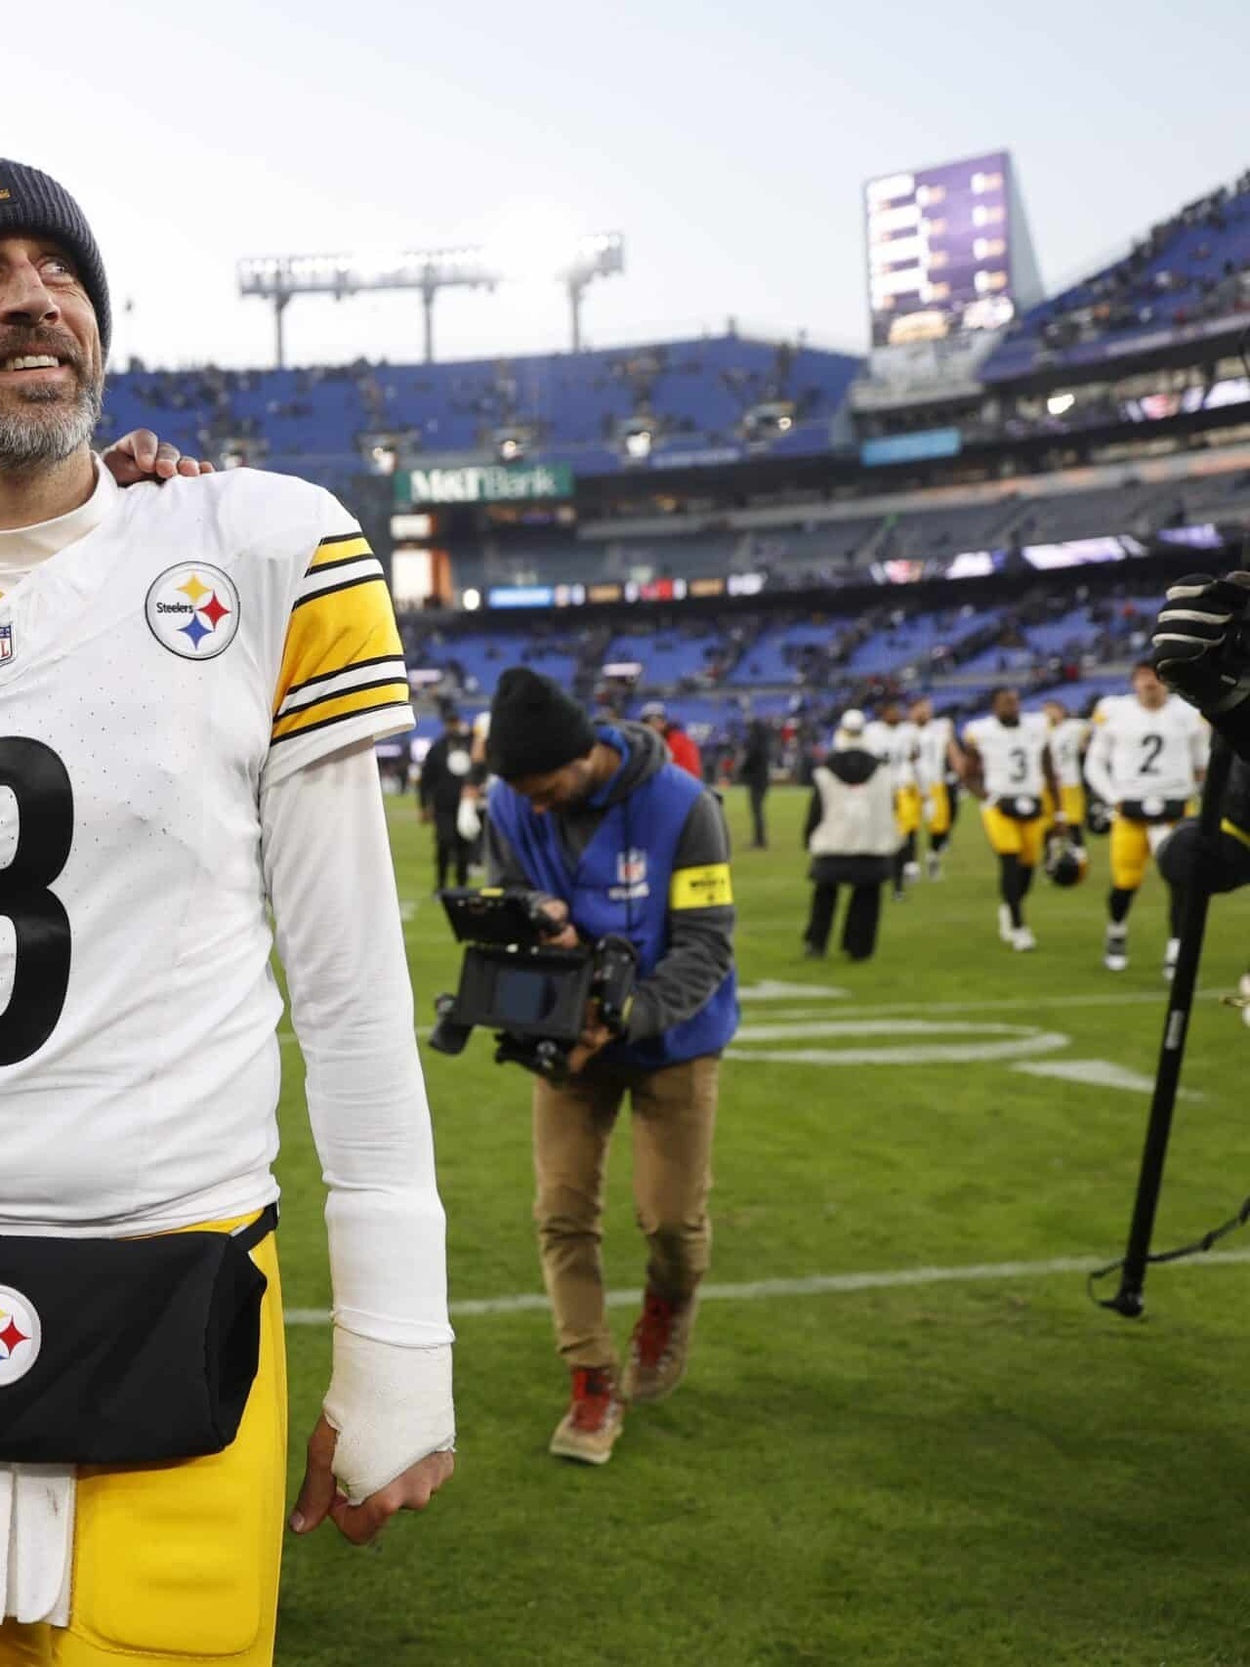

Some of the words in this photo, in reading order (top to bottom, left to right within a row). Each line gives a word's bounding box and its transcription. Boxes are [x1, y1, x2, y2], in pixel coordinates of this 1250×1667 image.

[485, 466, 555, 499] Bank
[156, 602, 194, 614] Steelers
[1009, 747, 1026, 783] 3
[1138, 734, 1164, 775] 2
